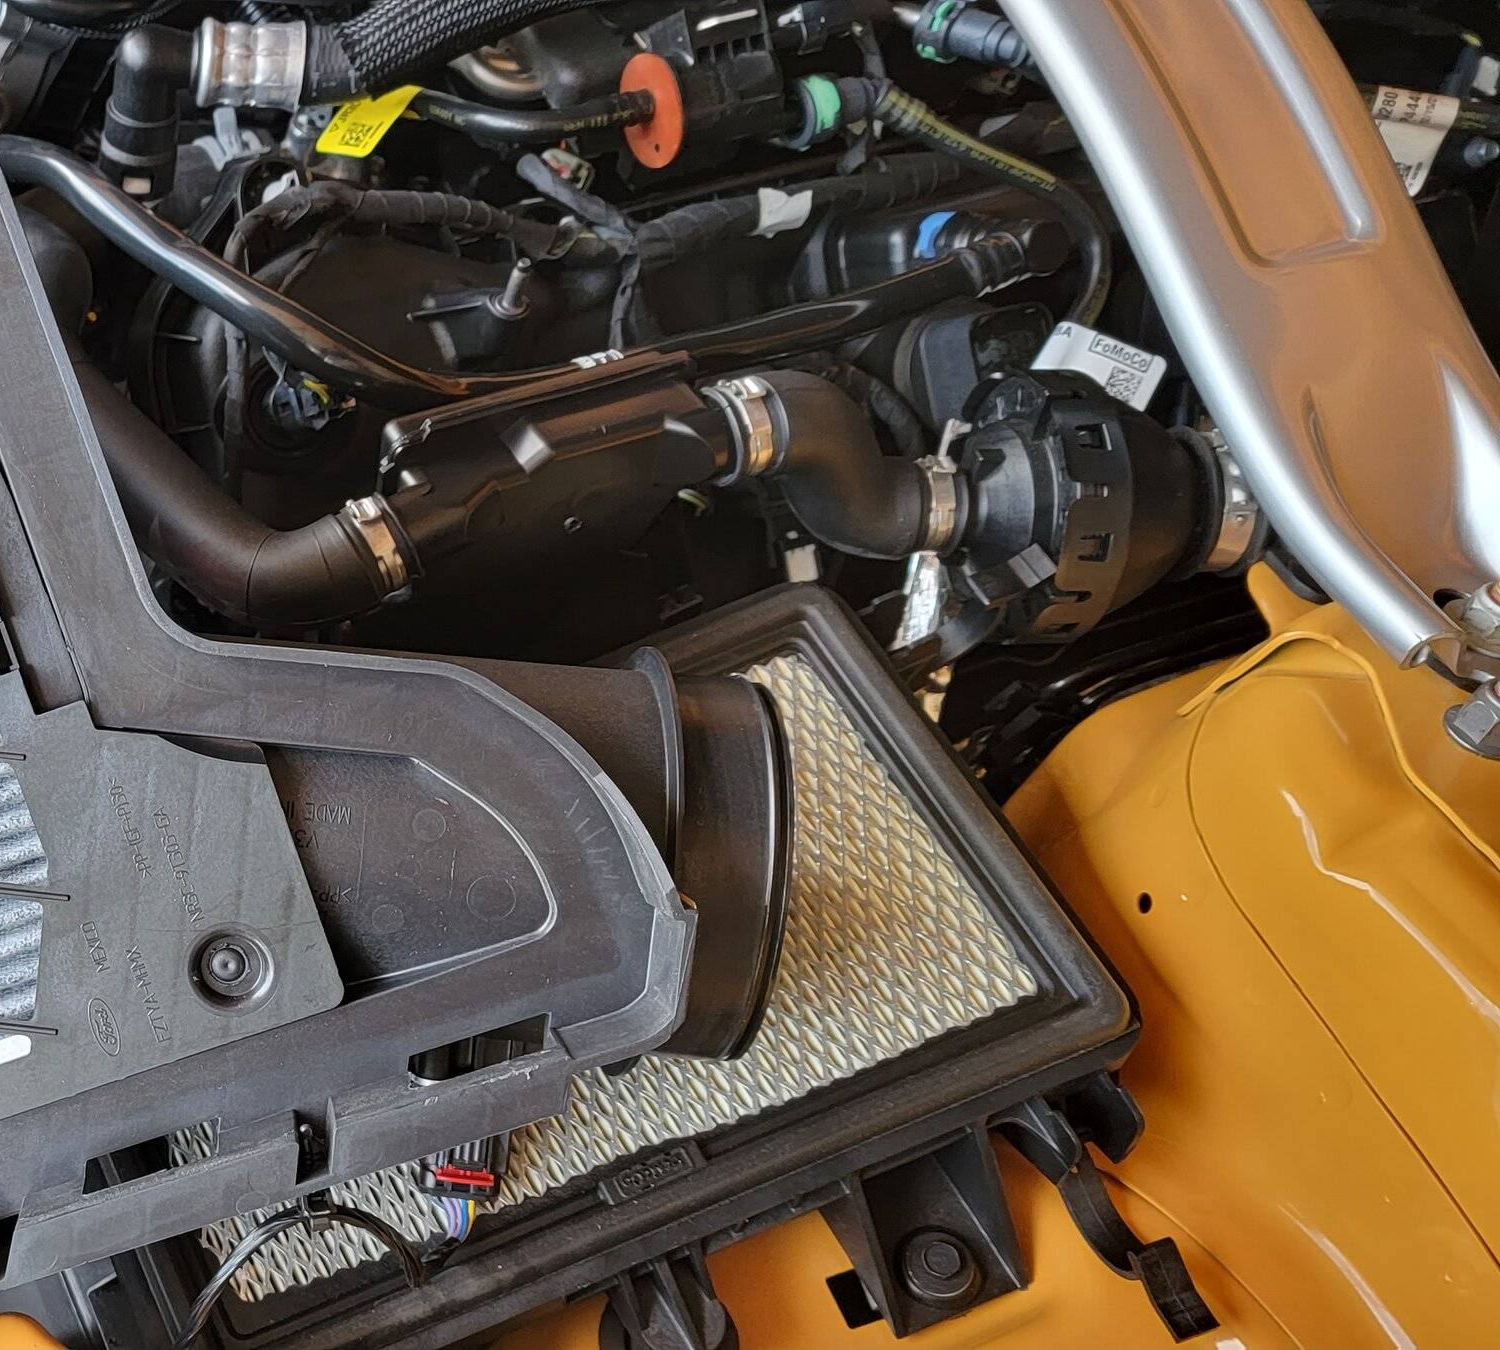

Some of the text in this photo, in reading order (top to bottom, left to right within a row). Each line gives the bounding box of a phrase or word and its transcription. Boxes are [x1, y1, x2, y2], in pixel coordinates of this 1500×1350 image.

[1094, 338, 1149, 369] FoMoCo
[304, 802, 352, 825] MADE
[80, 920, 111, 974] MEXICO
[91, 1005, 119, 1049] Ford
